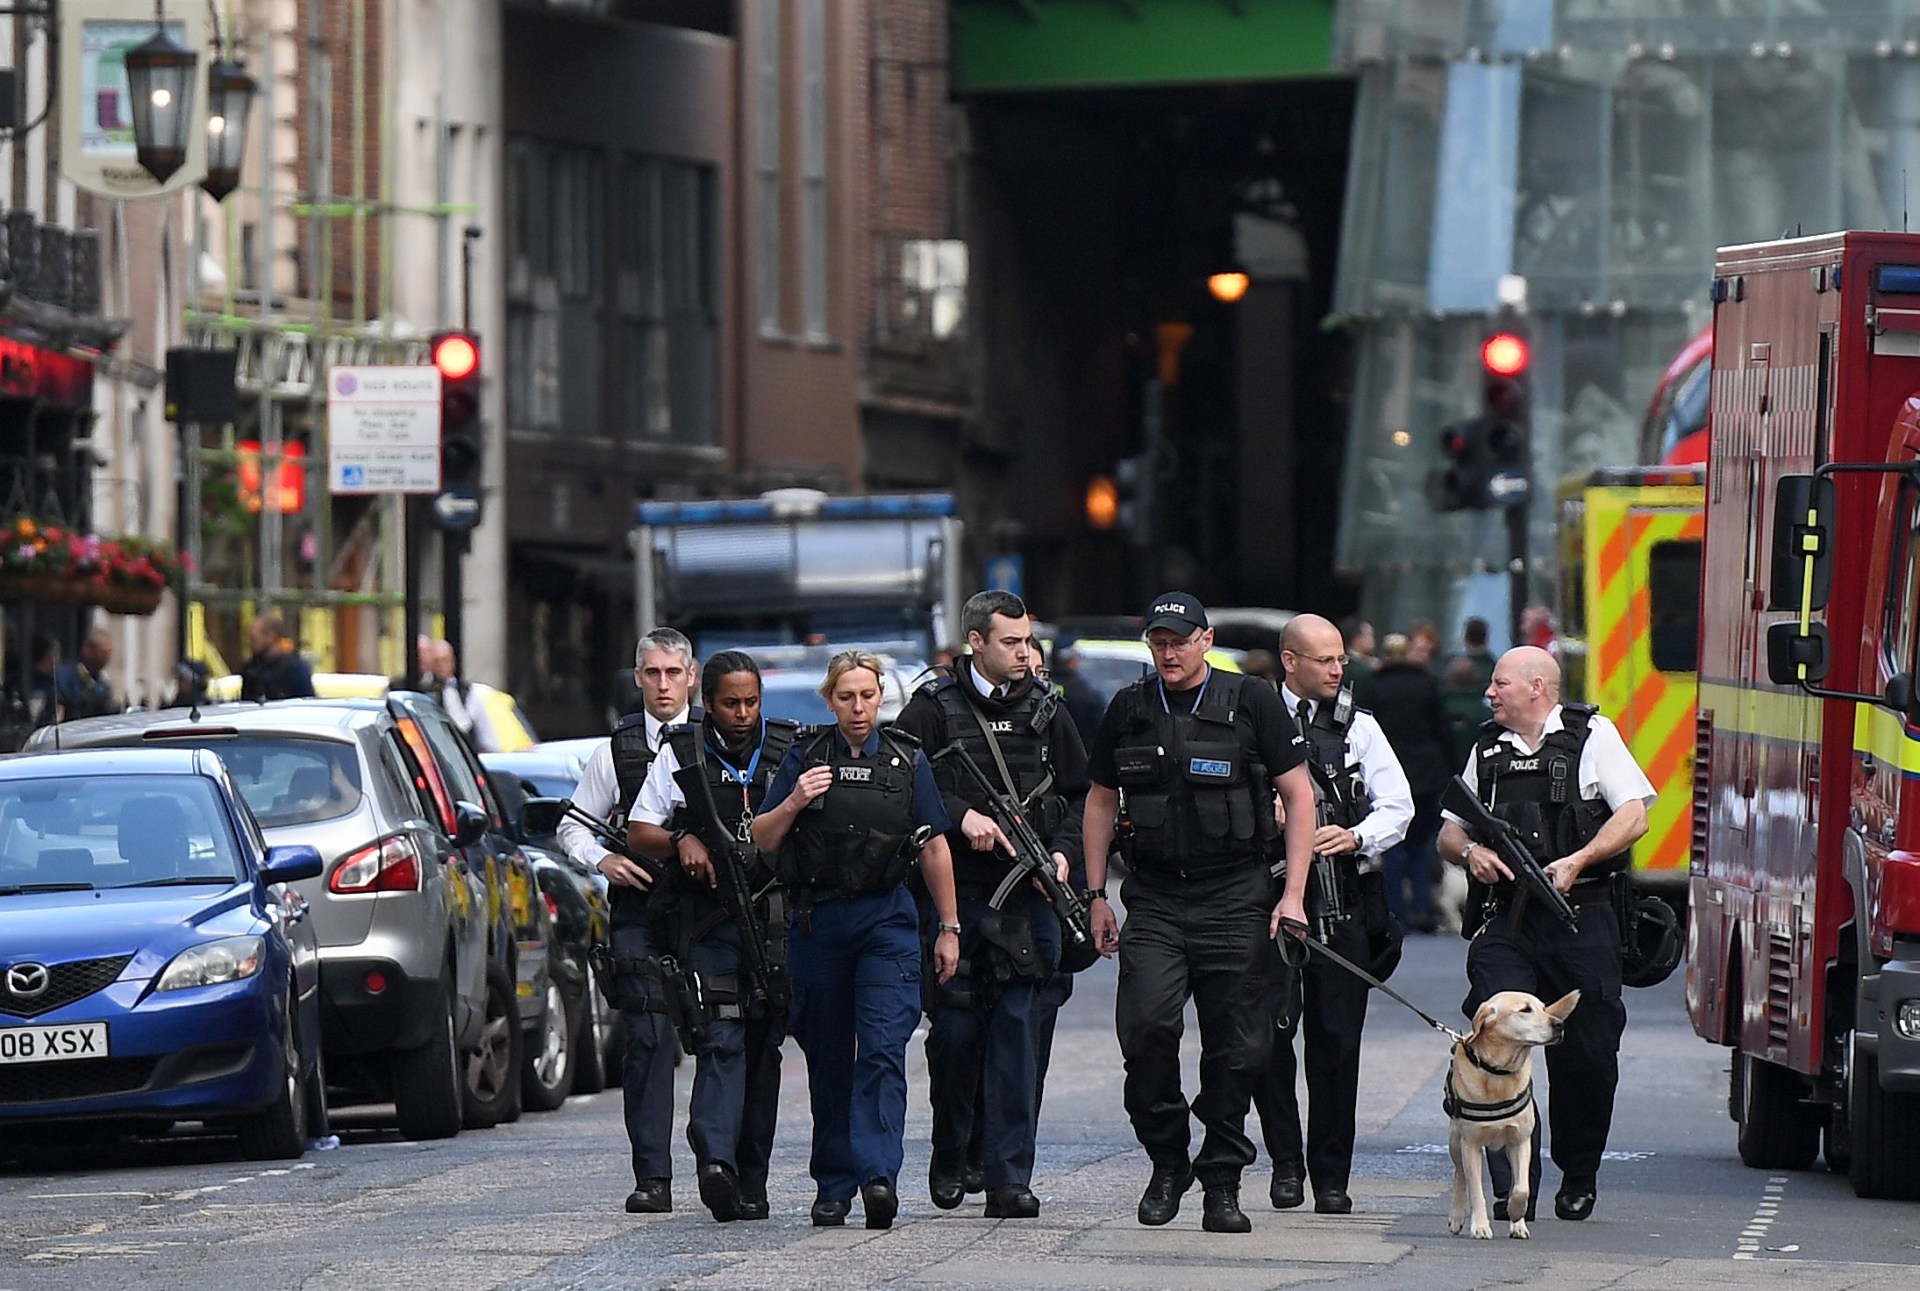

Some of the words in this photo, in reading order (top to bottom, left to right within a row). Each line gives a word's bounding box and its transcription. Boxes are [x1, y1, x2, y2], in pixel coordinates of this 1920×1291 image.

[1154, 602, 1186, 615] POLICE
[988, 720, 1013, 732] OLICE
[1509, 758, 1540, 771] POLICE
[840, 771, 871, 781] POLICE
[0, 1032, 35, 1058] 08
[43, 1028, 96, 1056] XSX
